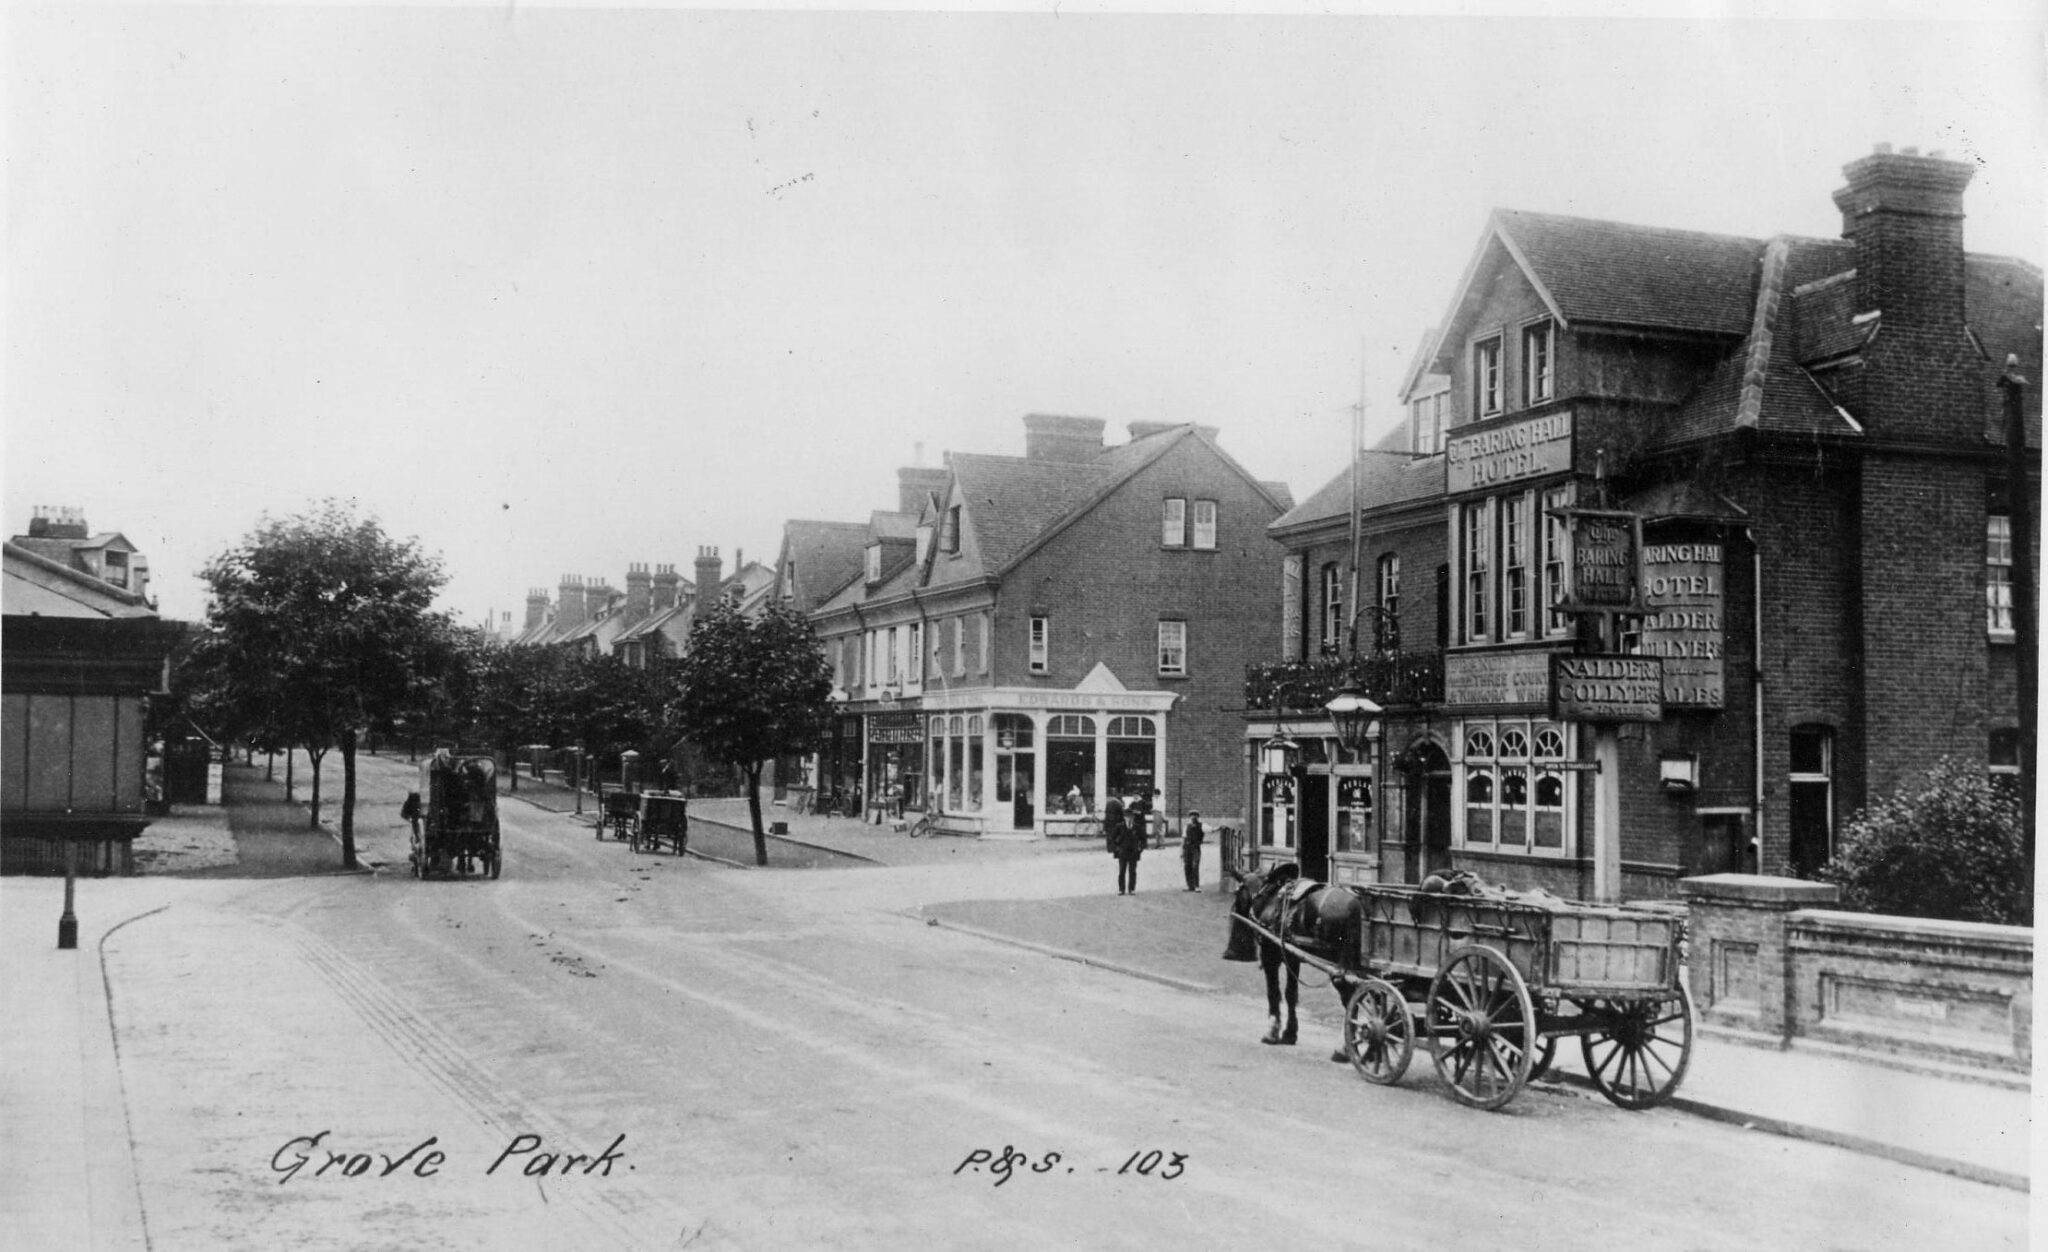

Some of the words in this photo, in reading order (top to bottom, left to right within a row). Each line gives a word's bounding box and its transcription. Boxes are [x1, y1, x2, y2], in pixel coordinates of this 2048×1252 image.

[1470, 428, 1527, 460] BARING
[1530, 417, 1571, 447] HALL
[1576, 548, 1628, 567] BARING
[1582, 567, 1625, 585] HALL
